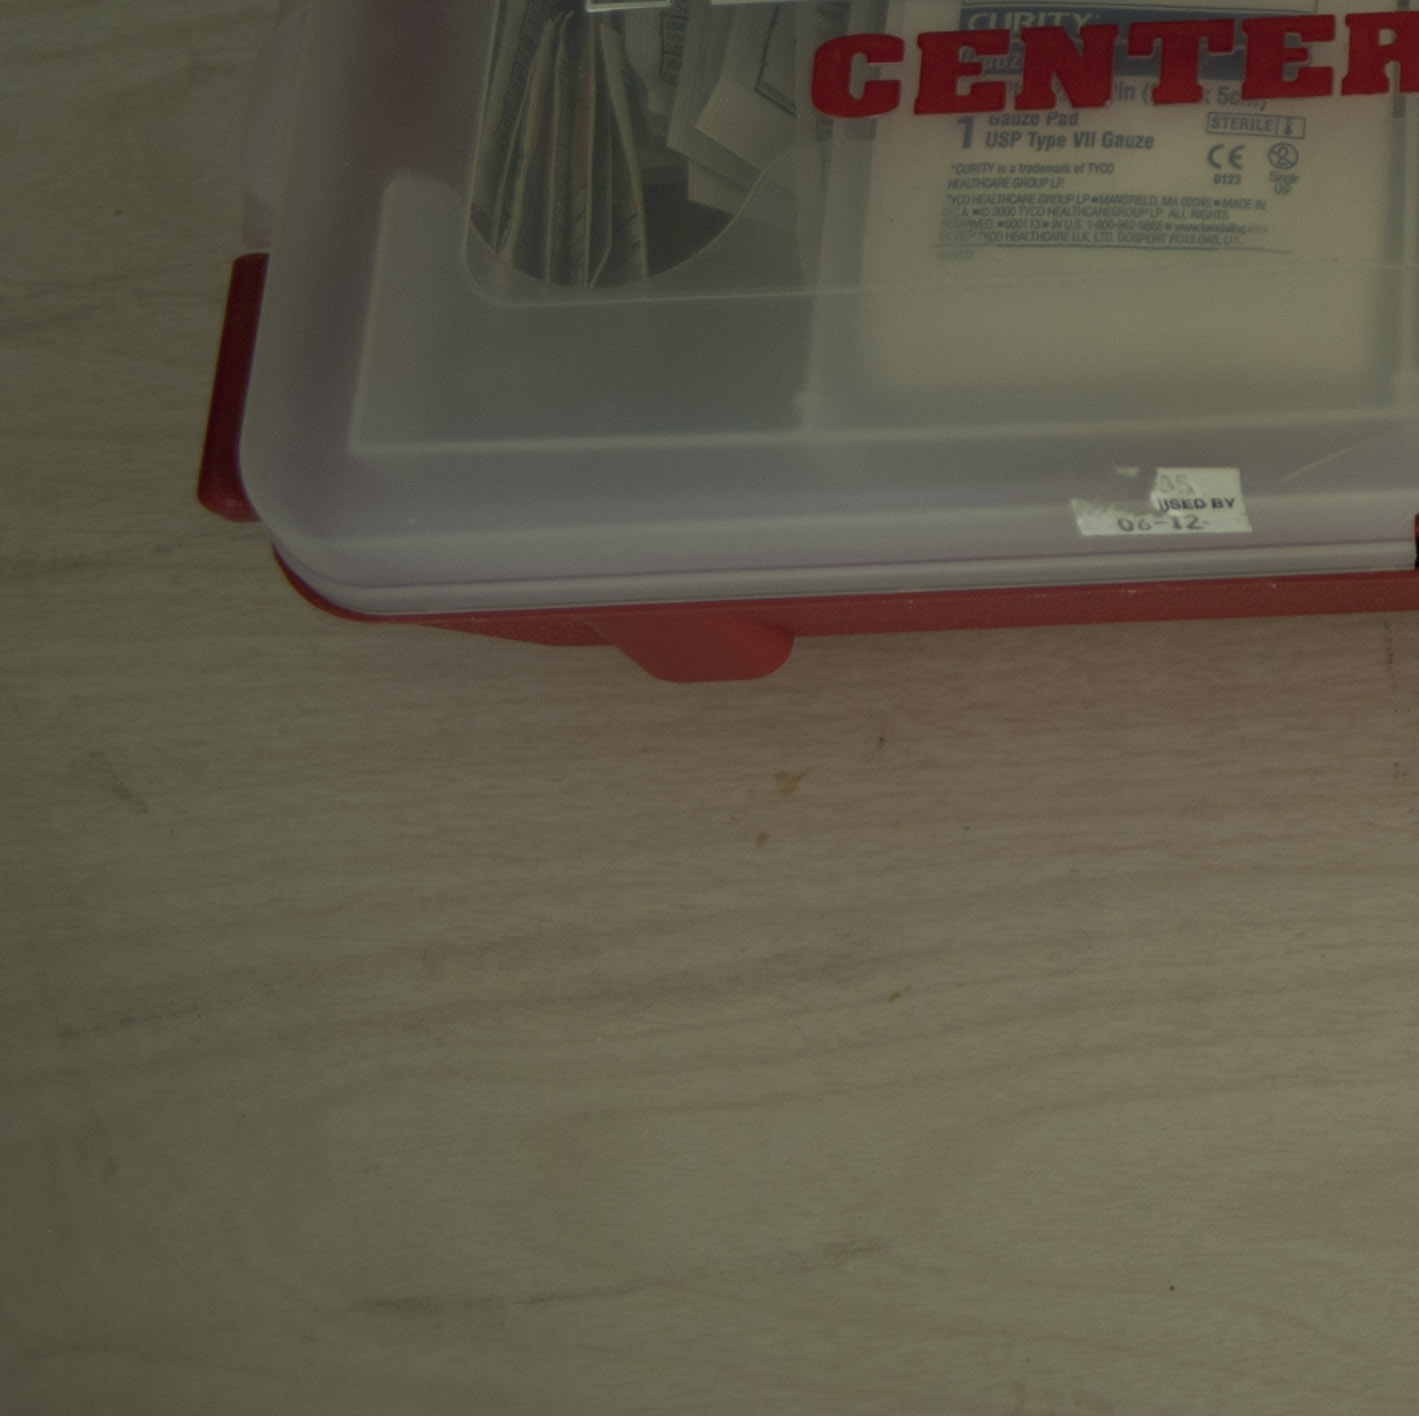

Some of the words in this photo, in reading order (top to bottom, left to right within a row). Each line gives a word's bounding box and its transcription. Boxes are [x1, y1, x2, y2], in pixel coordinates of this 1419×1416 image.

[1045, 111, 1080, 128] Pad
[1210, 116, 1276, 132] STERILE
[956, 116, 976, 150] 1
[985, 131, 1024, 149] USP
[1027, 131, 1068, 152] Type
[1100, 131, 1155, 150] Gauze
[1206, 143, 1247, 170] CE
[1018, 163, 1072, 174] trademark
[1073, 163, 1085, 174] of
[1087, 163, 1116, 174] TYCO
[948, 176, 1012, 190] HEALTHCARE
[1012, 176, 1050, 190] GROUP
[1213, 173, 1243, 186] 0123
[971, 193, 1037, 206] HEALTHCARE
[1038, 193, 1074, 206] GROUP
[1221, 197, 1253, 210] MADE
[1254, 199, 1268, 211] IN
[1018, 206, 1045, 218] TYCO
[1168, 208, 1188, 220] ALL
[1190, 209, 1230, 221] RIGHTS
[1004, 232, 1070, 243] HEALTHCARE
[1117, 233, 1166, 244] GOSPORT
[1156, 498, 1207, 512] USED
[1211, 498, 1235, 509] BY
